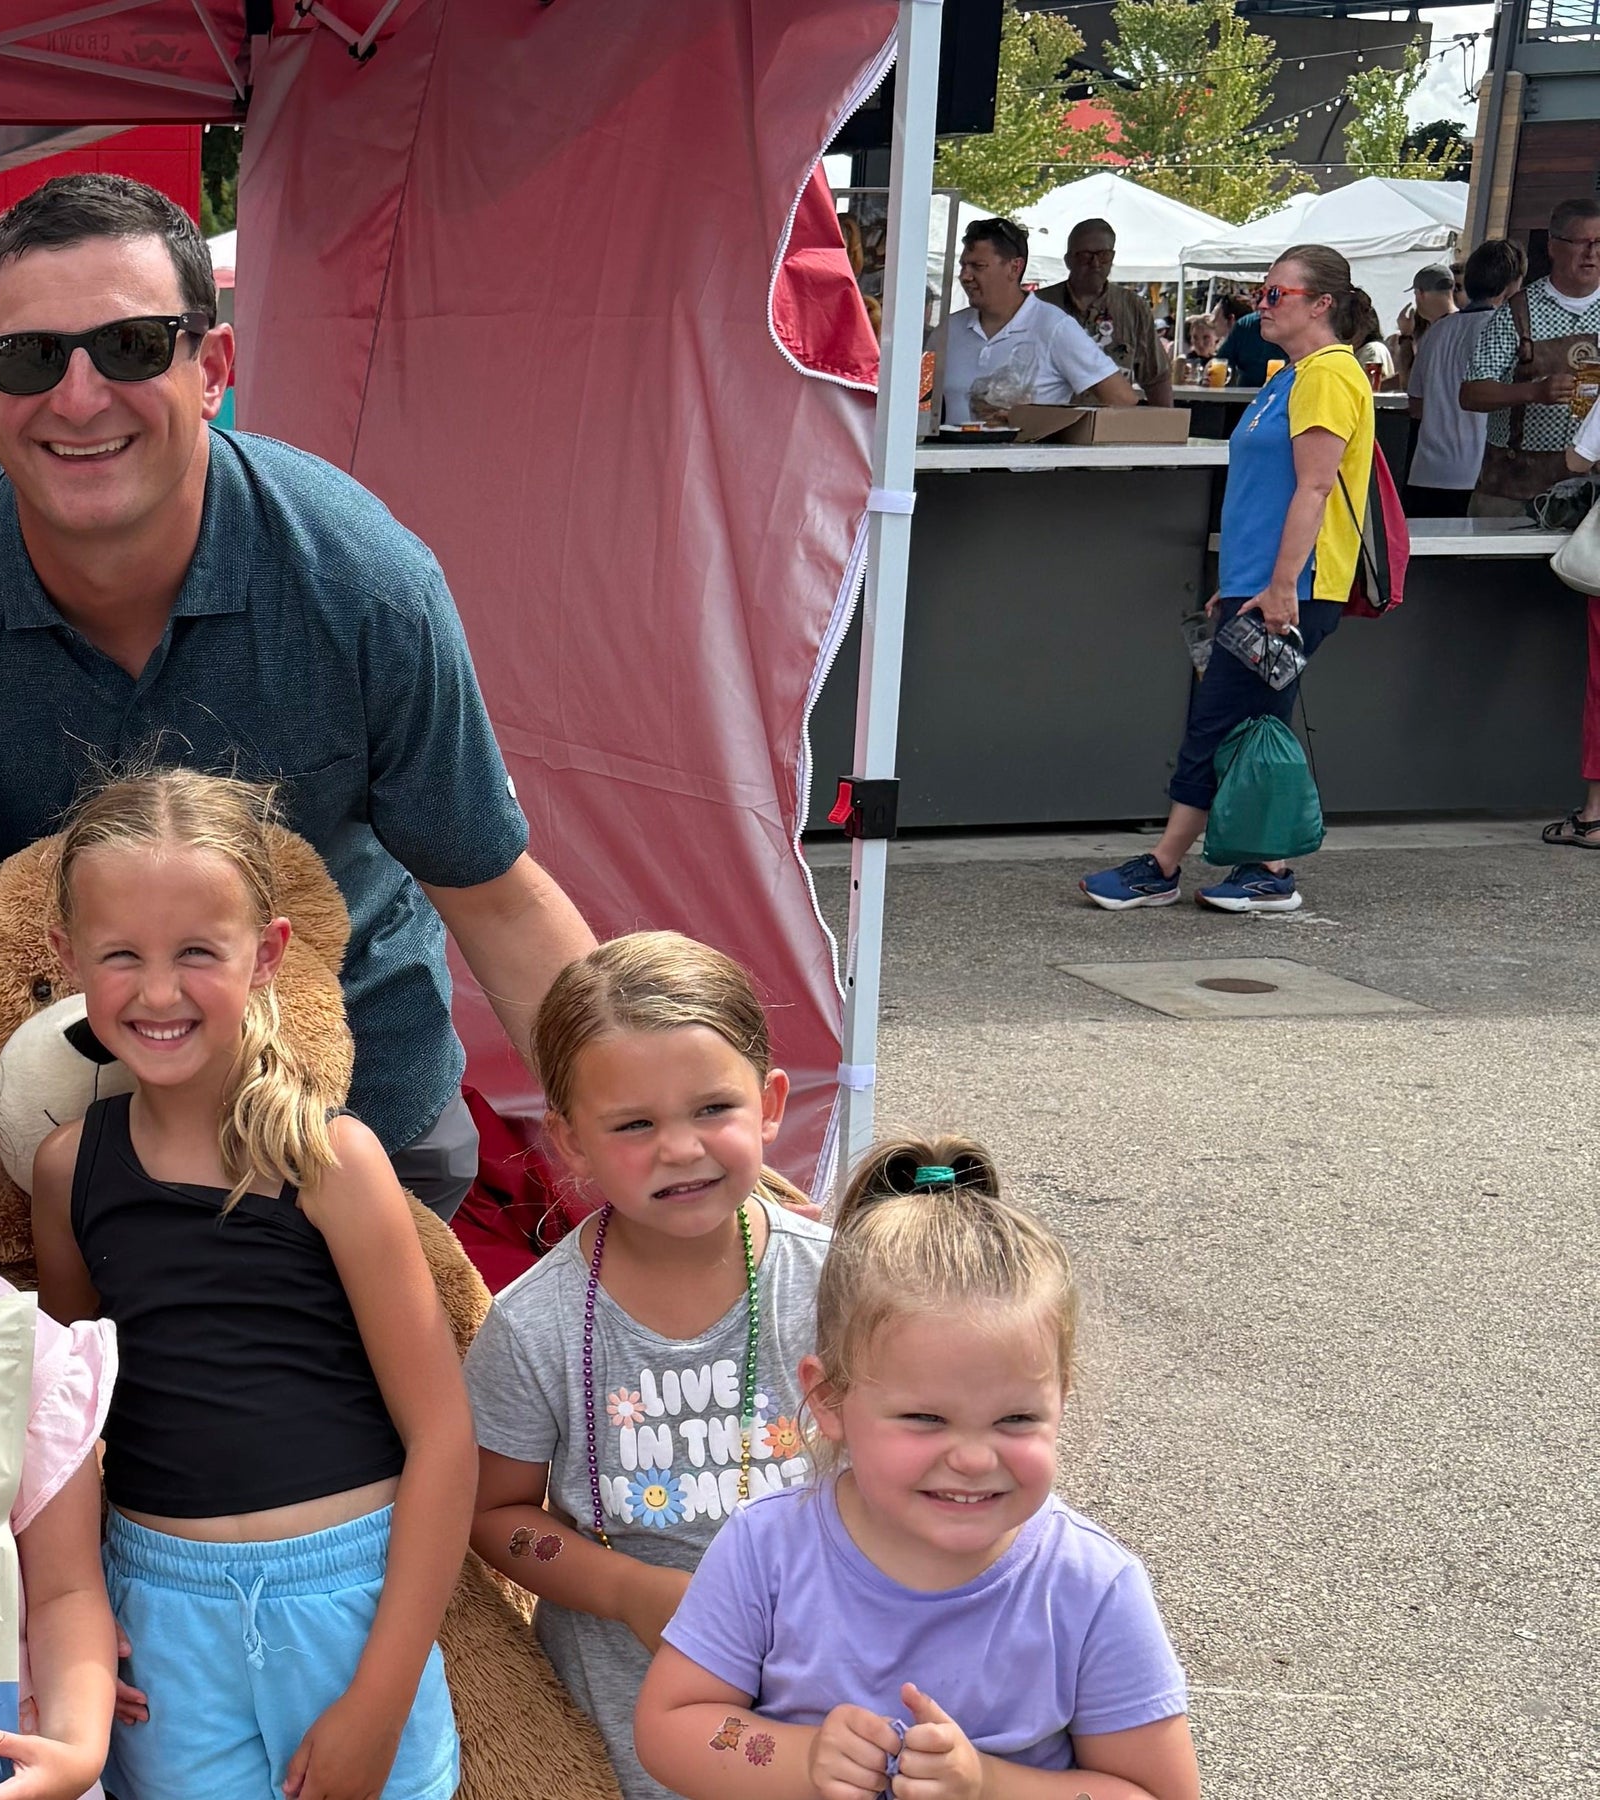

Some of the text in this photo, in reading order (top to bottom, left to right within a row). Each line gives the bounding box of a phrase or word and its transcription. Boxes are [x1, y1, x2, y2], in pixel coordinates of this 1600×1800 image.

[640, 1360, 740, 1417] LIVE
[620, 1412, 774, 1471] IN THE
